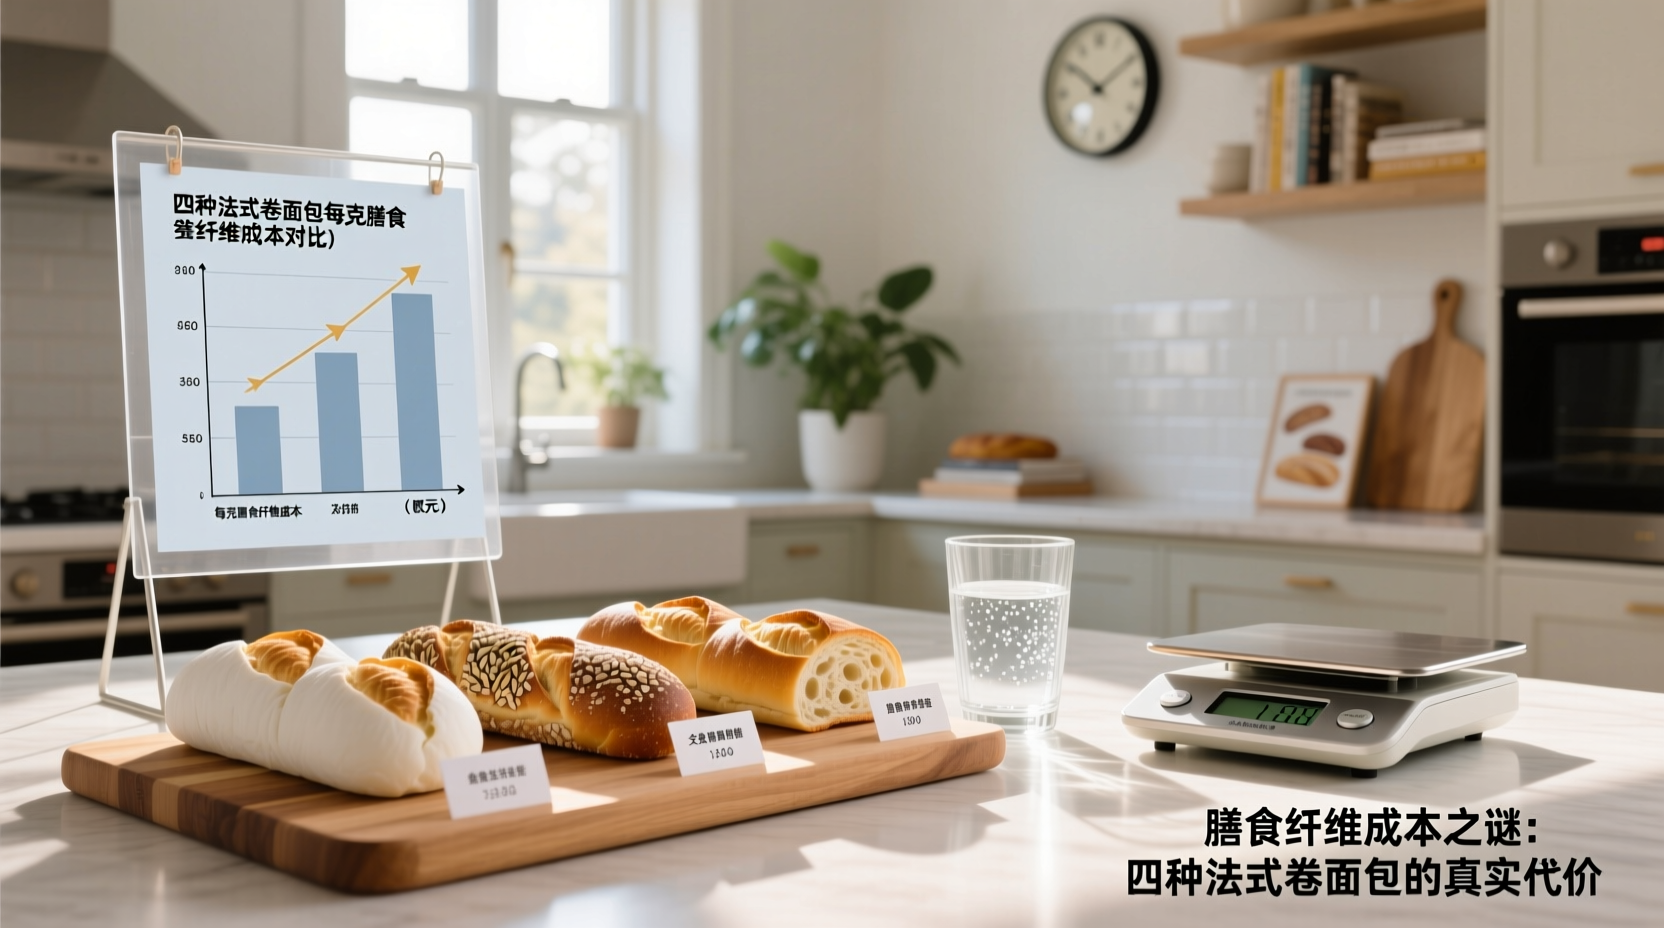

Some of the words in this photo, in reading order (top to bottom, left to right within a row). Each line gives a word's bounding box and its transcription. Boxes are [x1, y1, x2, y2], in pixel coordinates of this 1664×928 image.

[173, 193, 407, 229] 四种法式卷面包每克膳食
